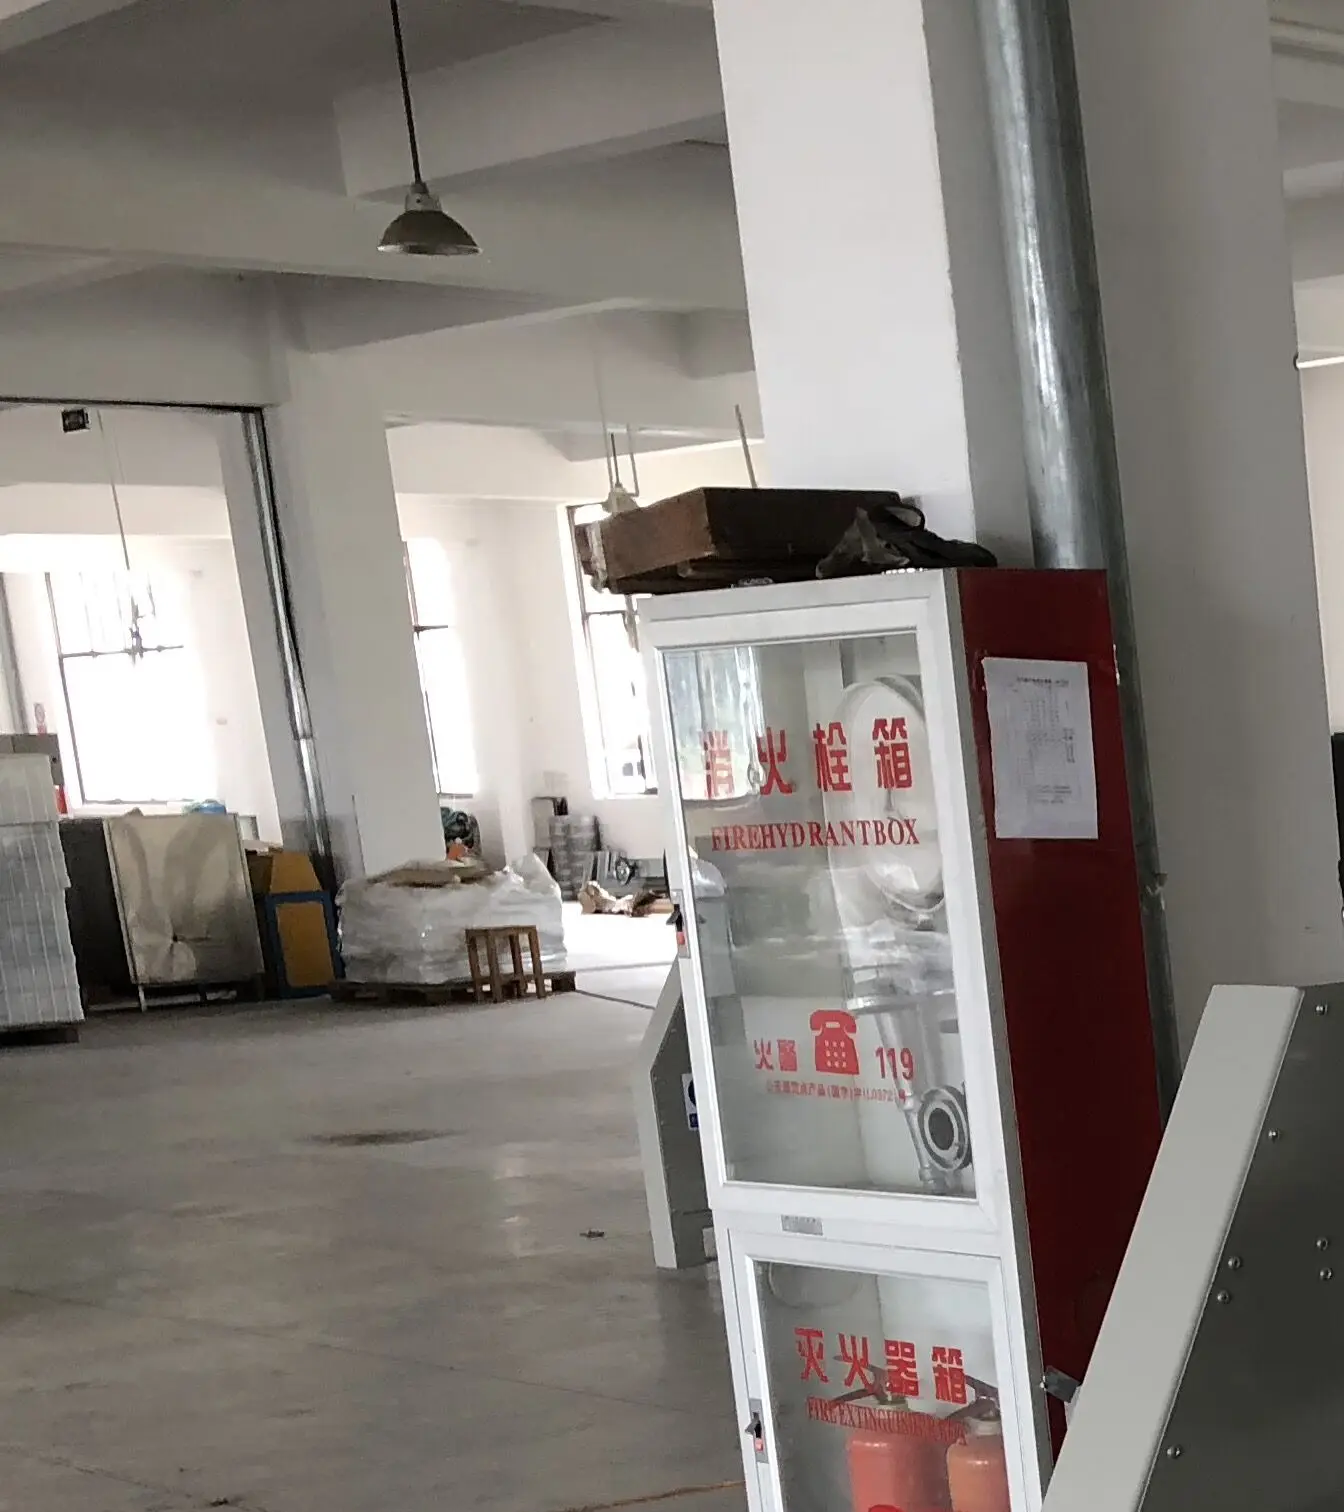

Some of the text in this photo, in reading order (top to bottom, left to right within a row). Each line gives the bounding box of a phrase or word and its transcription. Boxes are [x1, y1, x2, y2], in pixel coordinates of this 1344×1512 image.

[703, 717, 913, 799] 消火栓箱
[875, 1046, 914, 1081] 119
[794, 1327, 968, 1405] 灭火器箱
